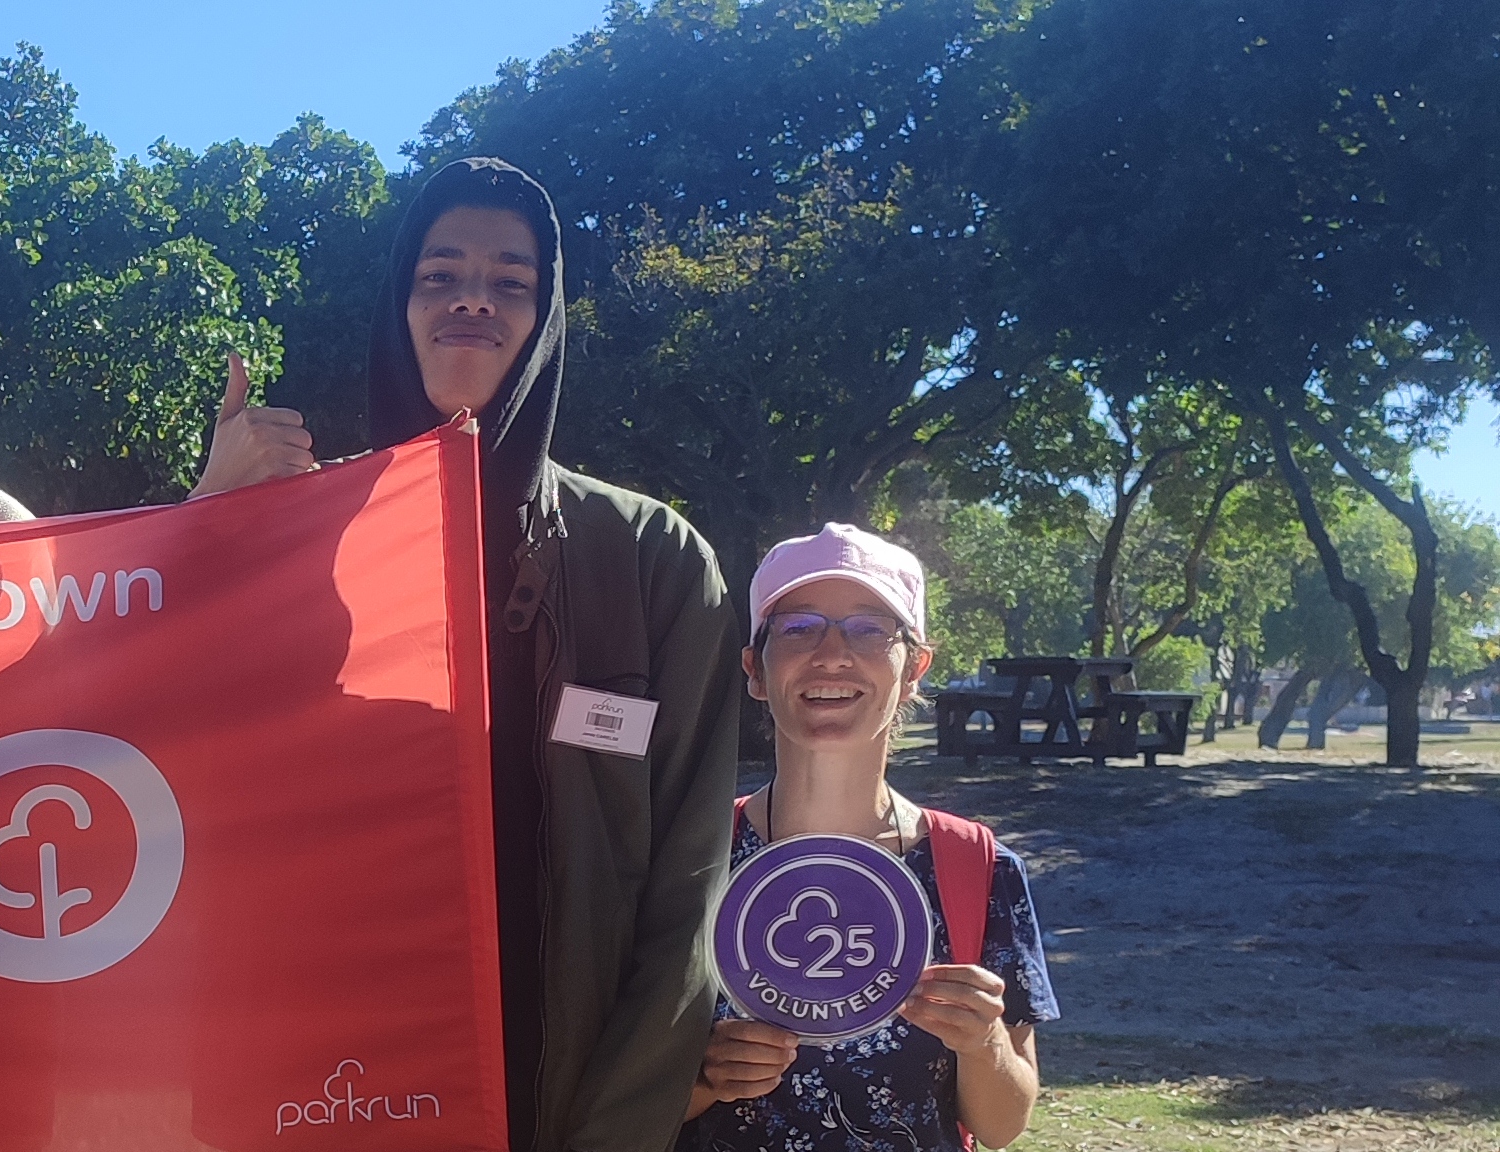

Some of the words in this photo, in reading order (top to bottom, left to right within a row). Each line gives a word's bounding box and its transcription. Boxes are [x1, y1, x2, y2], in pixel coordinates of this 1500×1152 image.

[805, 926, 875, 978] 25
[748, 970, 898, 1020] VOLUNTEER
[275, 1058, 441, 1136] parkrun
